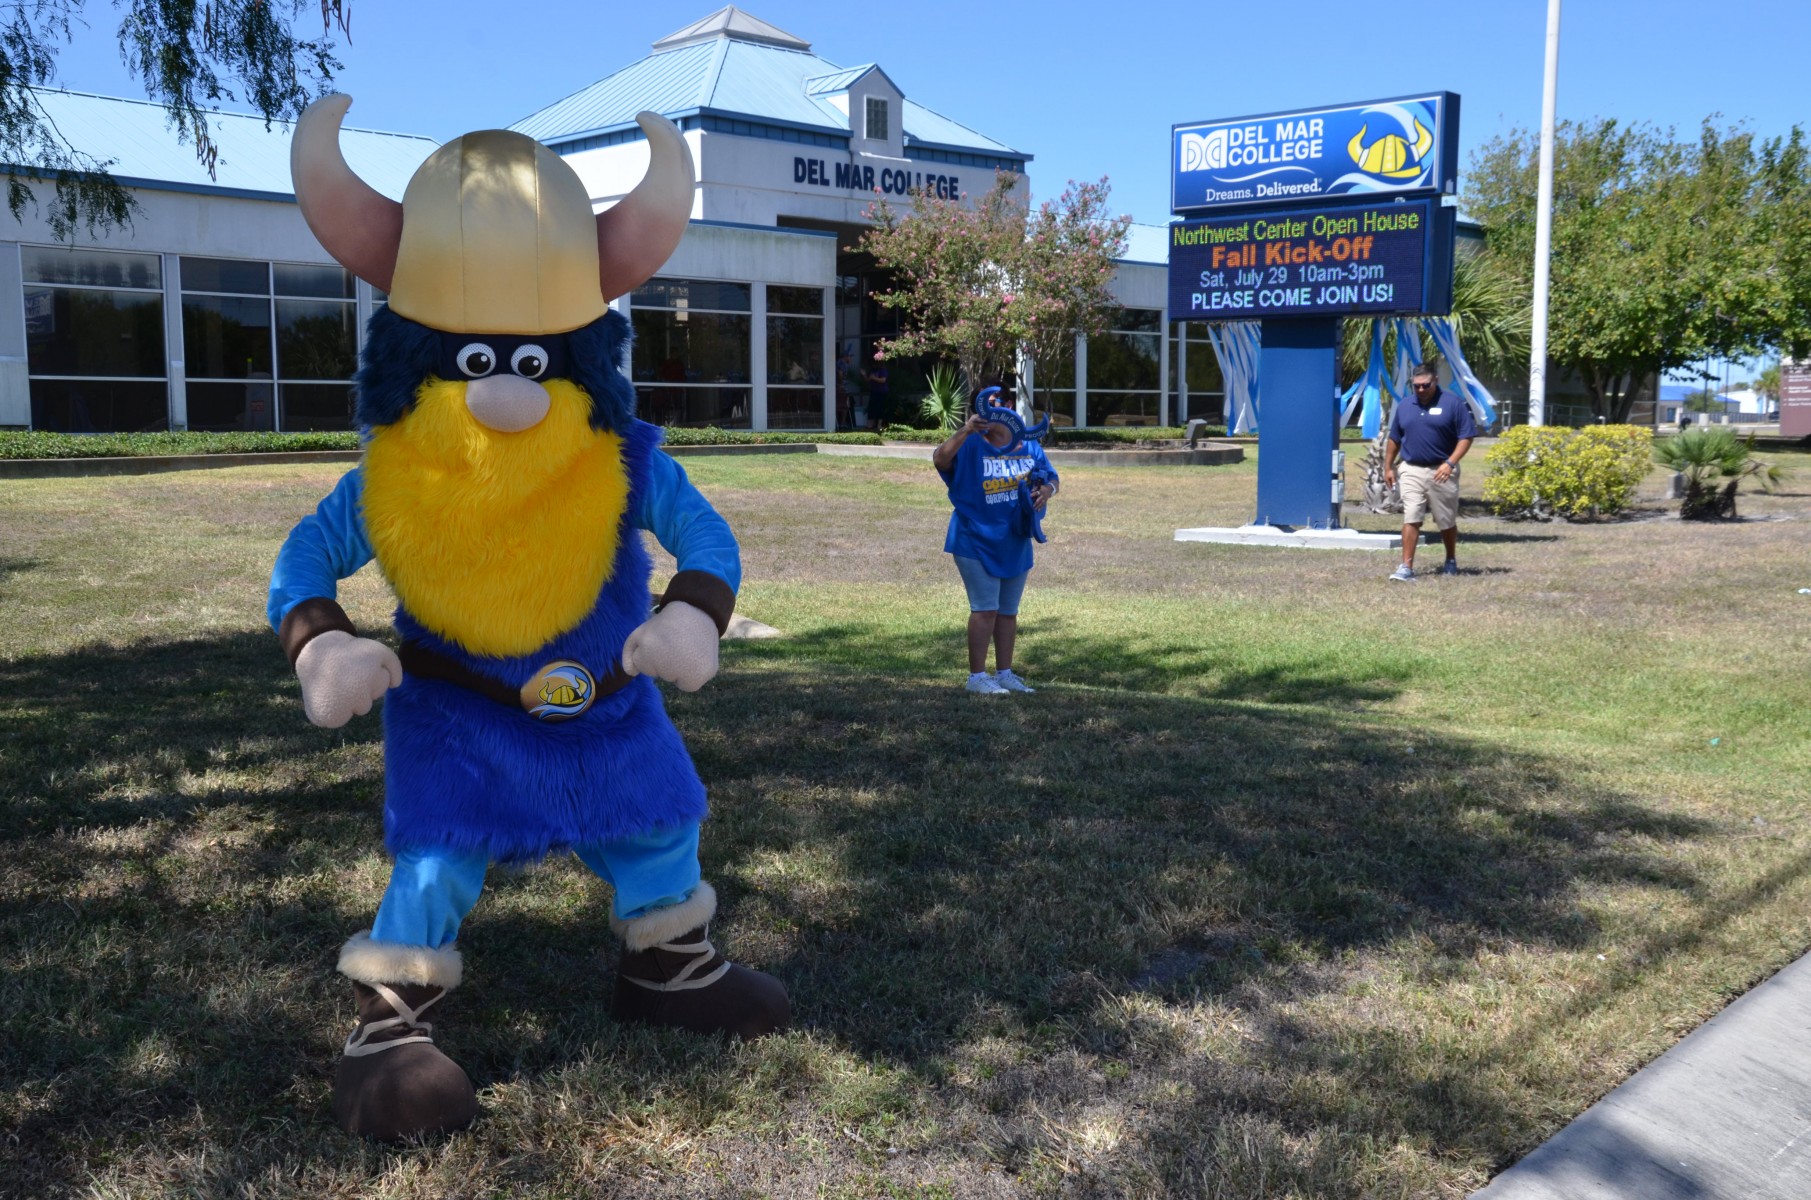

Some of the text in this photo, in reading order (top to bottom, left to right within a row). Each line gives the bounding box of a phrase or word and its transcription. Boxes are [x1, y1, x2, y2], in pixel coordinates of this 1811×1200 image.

[1229, 118, 1324, 147] DEL MAR
[1228, 139, 1323, 167] COLLEGE
[794, 156, 959, 201] DEL MAR COLLEGE
[1206, 188, 1254, 202] Dreams.
[1174, 211, 1419, 246] Northwest Center Open House
[1212, 235, 1374, 269] Fall Kick-Off
[1200, 262, 1385, 289] Sat, July 29 10am-3pm
[1192, 283, 1394, 310] PLEASE COME JOIN US!
[983, 458, 1010, 477] DEL
